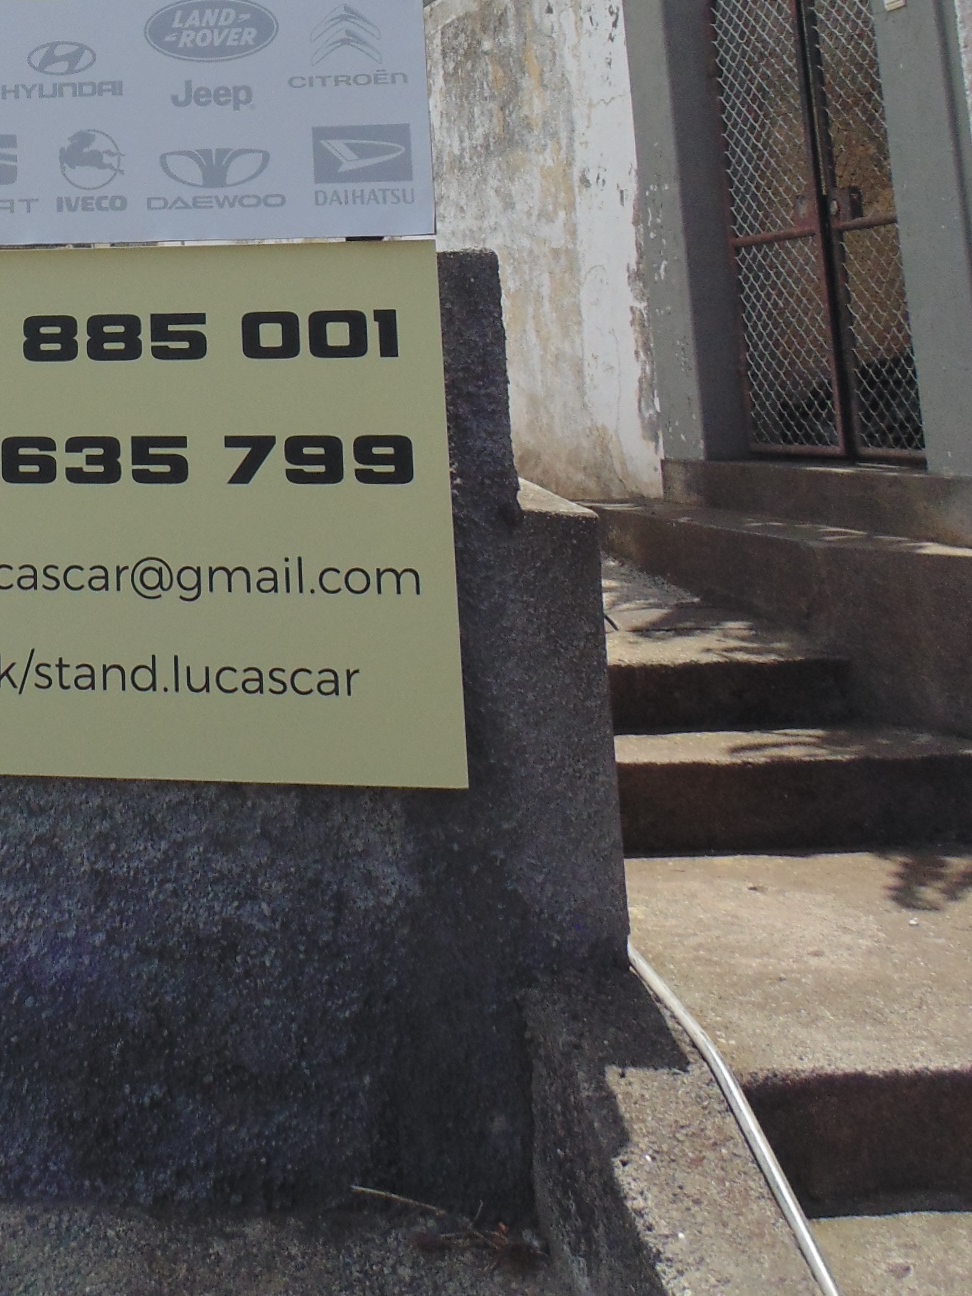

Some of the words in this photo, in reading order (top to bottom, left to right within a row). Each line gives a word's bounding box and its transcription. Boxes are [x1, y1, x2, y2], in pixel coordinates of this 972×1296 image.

[171, 7, 234, 29] LAND
[179, 26, 258, 48] ROVER
[0, 81, 124, 100] HYUNDAI
[171, 79, 254, 111] Jeep
[56, 195, 128, 213] IVECO
[146, 193, 287, 210] DAEWOO
[314, 188, 415, 206] DAIHATSU
[22, 312, 208, 362] 885
[240, 309, 401, 359] 001
[1, 436, 189, 485] 635
[223, 434, 415, 485] 799
